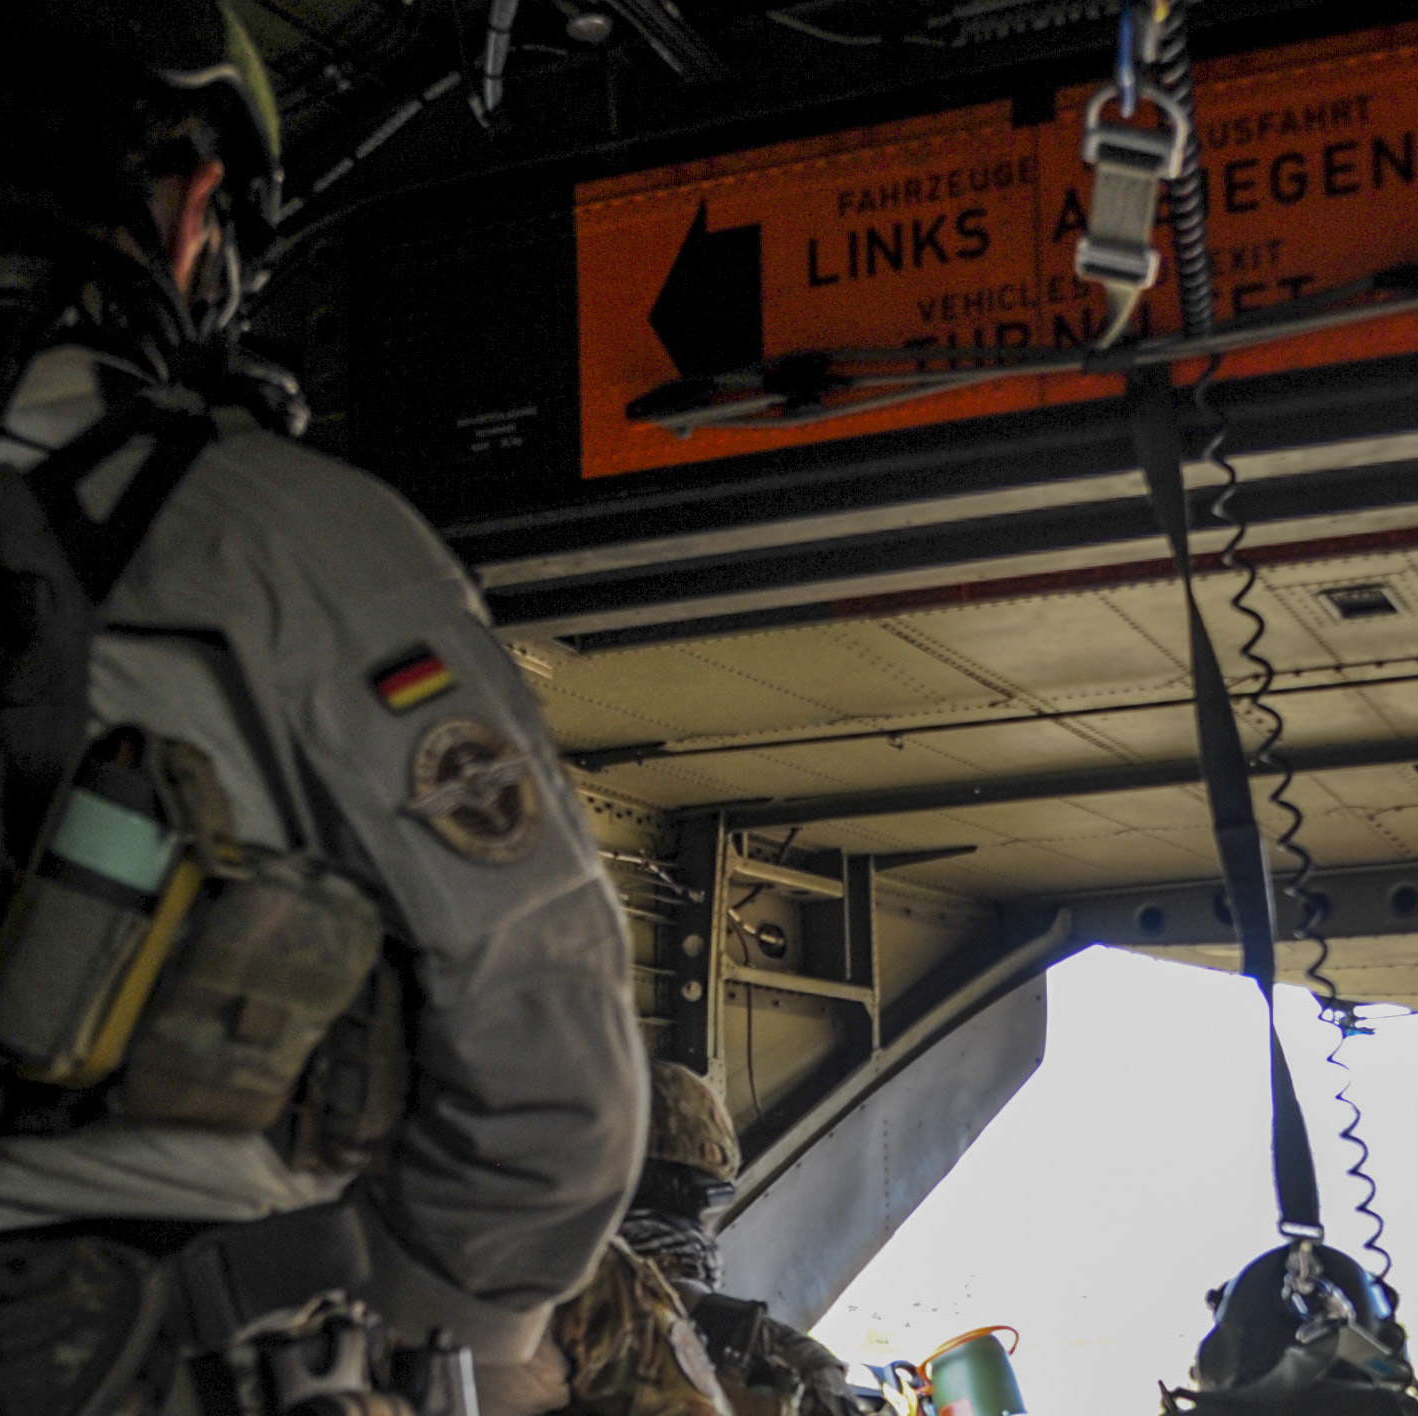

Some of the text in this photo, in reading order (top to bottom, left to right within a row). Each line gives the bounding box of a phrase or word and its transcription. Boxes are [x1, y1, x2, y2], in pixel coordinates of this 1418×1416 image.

[808, 130, 1415, 287] LINKS AIEGEN
[837, 95, 1372, 218] FAHRZEUGE USFAHRT
